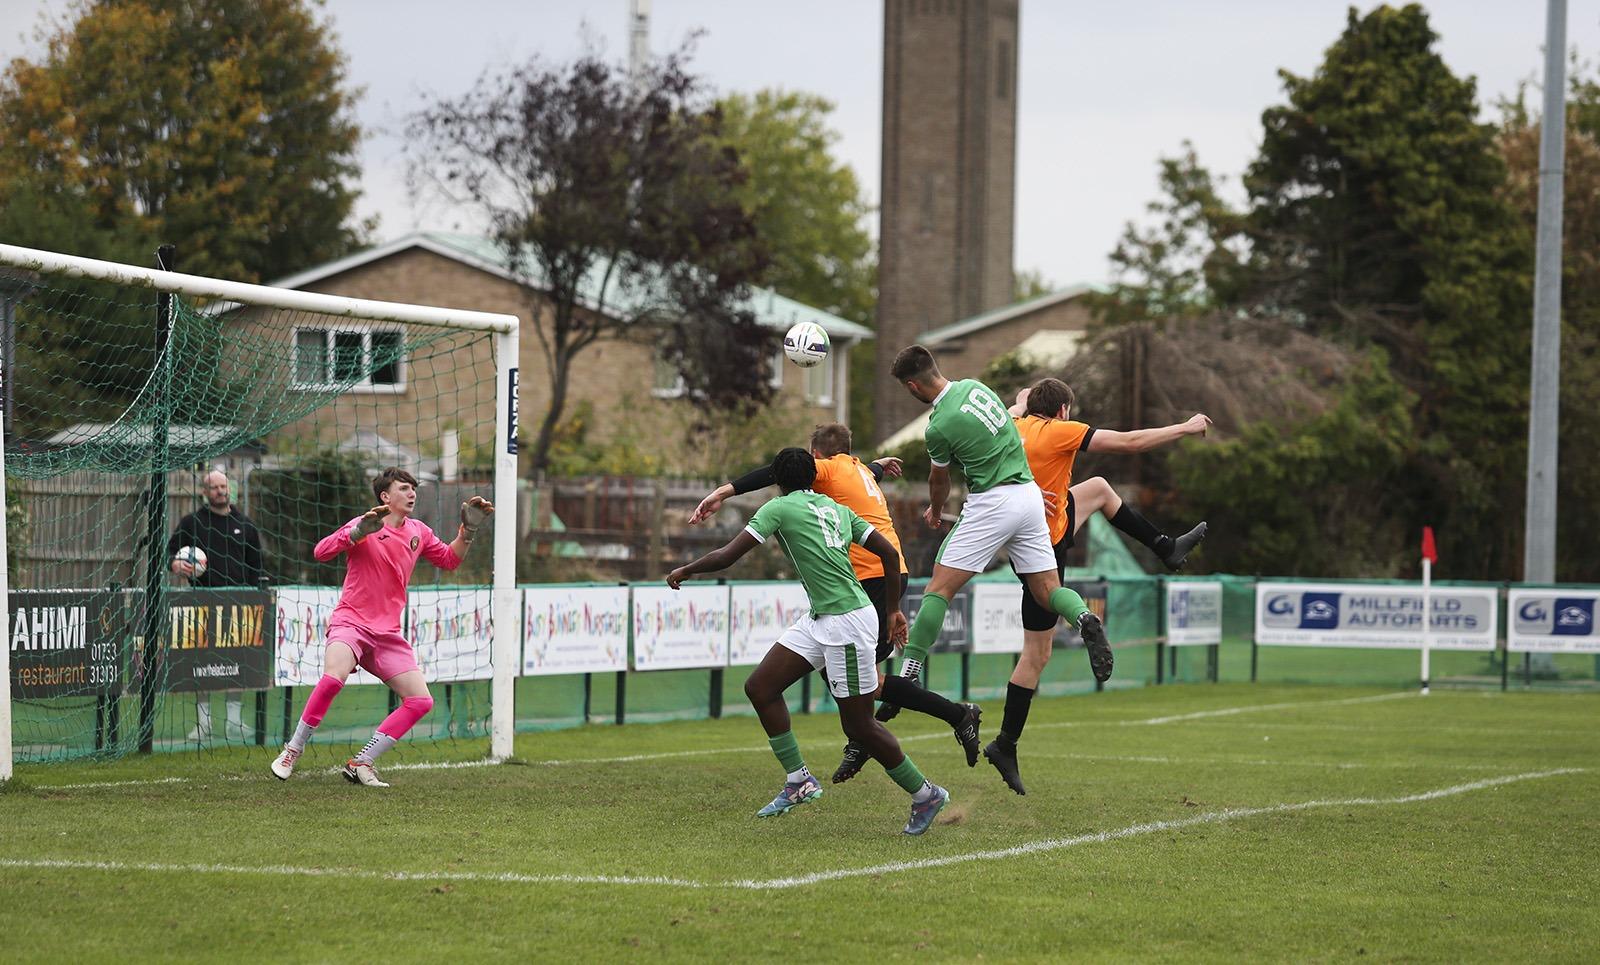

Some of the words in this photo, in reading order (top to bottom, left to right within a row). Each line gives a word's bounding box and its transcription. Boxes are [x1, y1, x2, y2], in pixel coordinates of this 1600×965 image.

[960, 388, 1008, 437] 18
[857, 465, 883, 506] 4
[10, 606, 87, 651] AHIMI
[169, 605, 209, 649] THE
[215, 605, 265, 648] LADZ
[91, 643, 117, 661] 01733
[18, 662, 86, 686] restaurant
[89, 665, 118, 684] 313131
